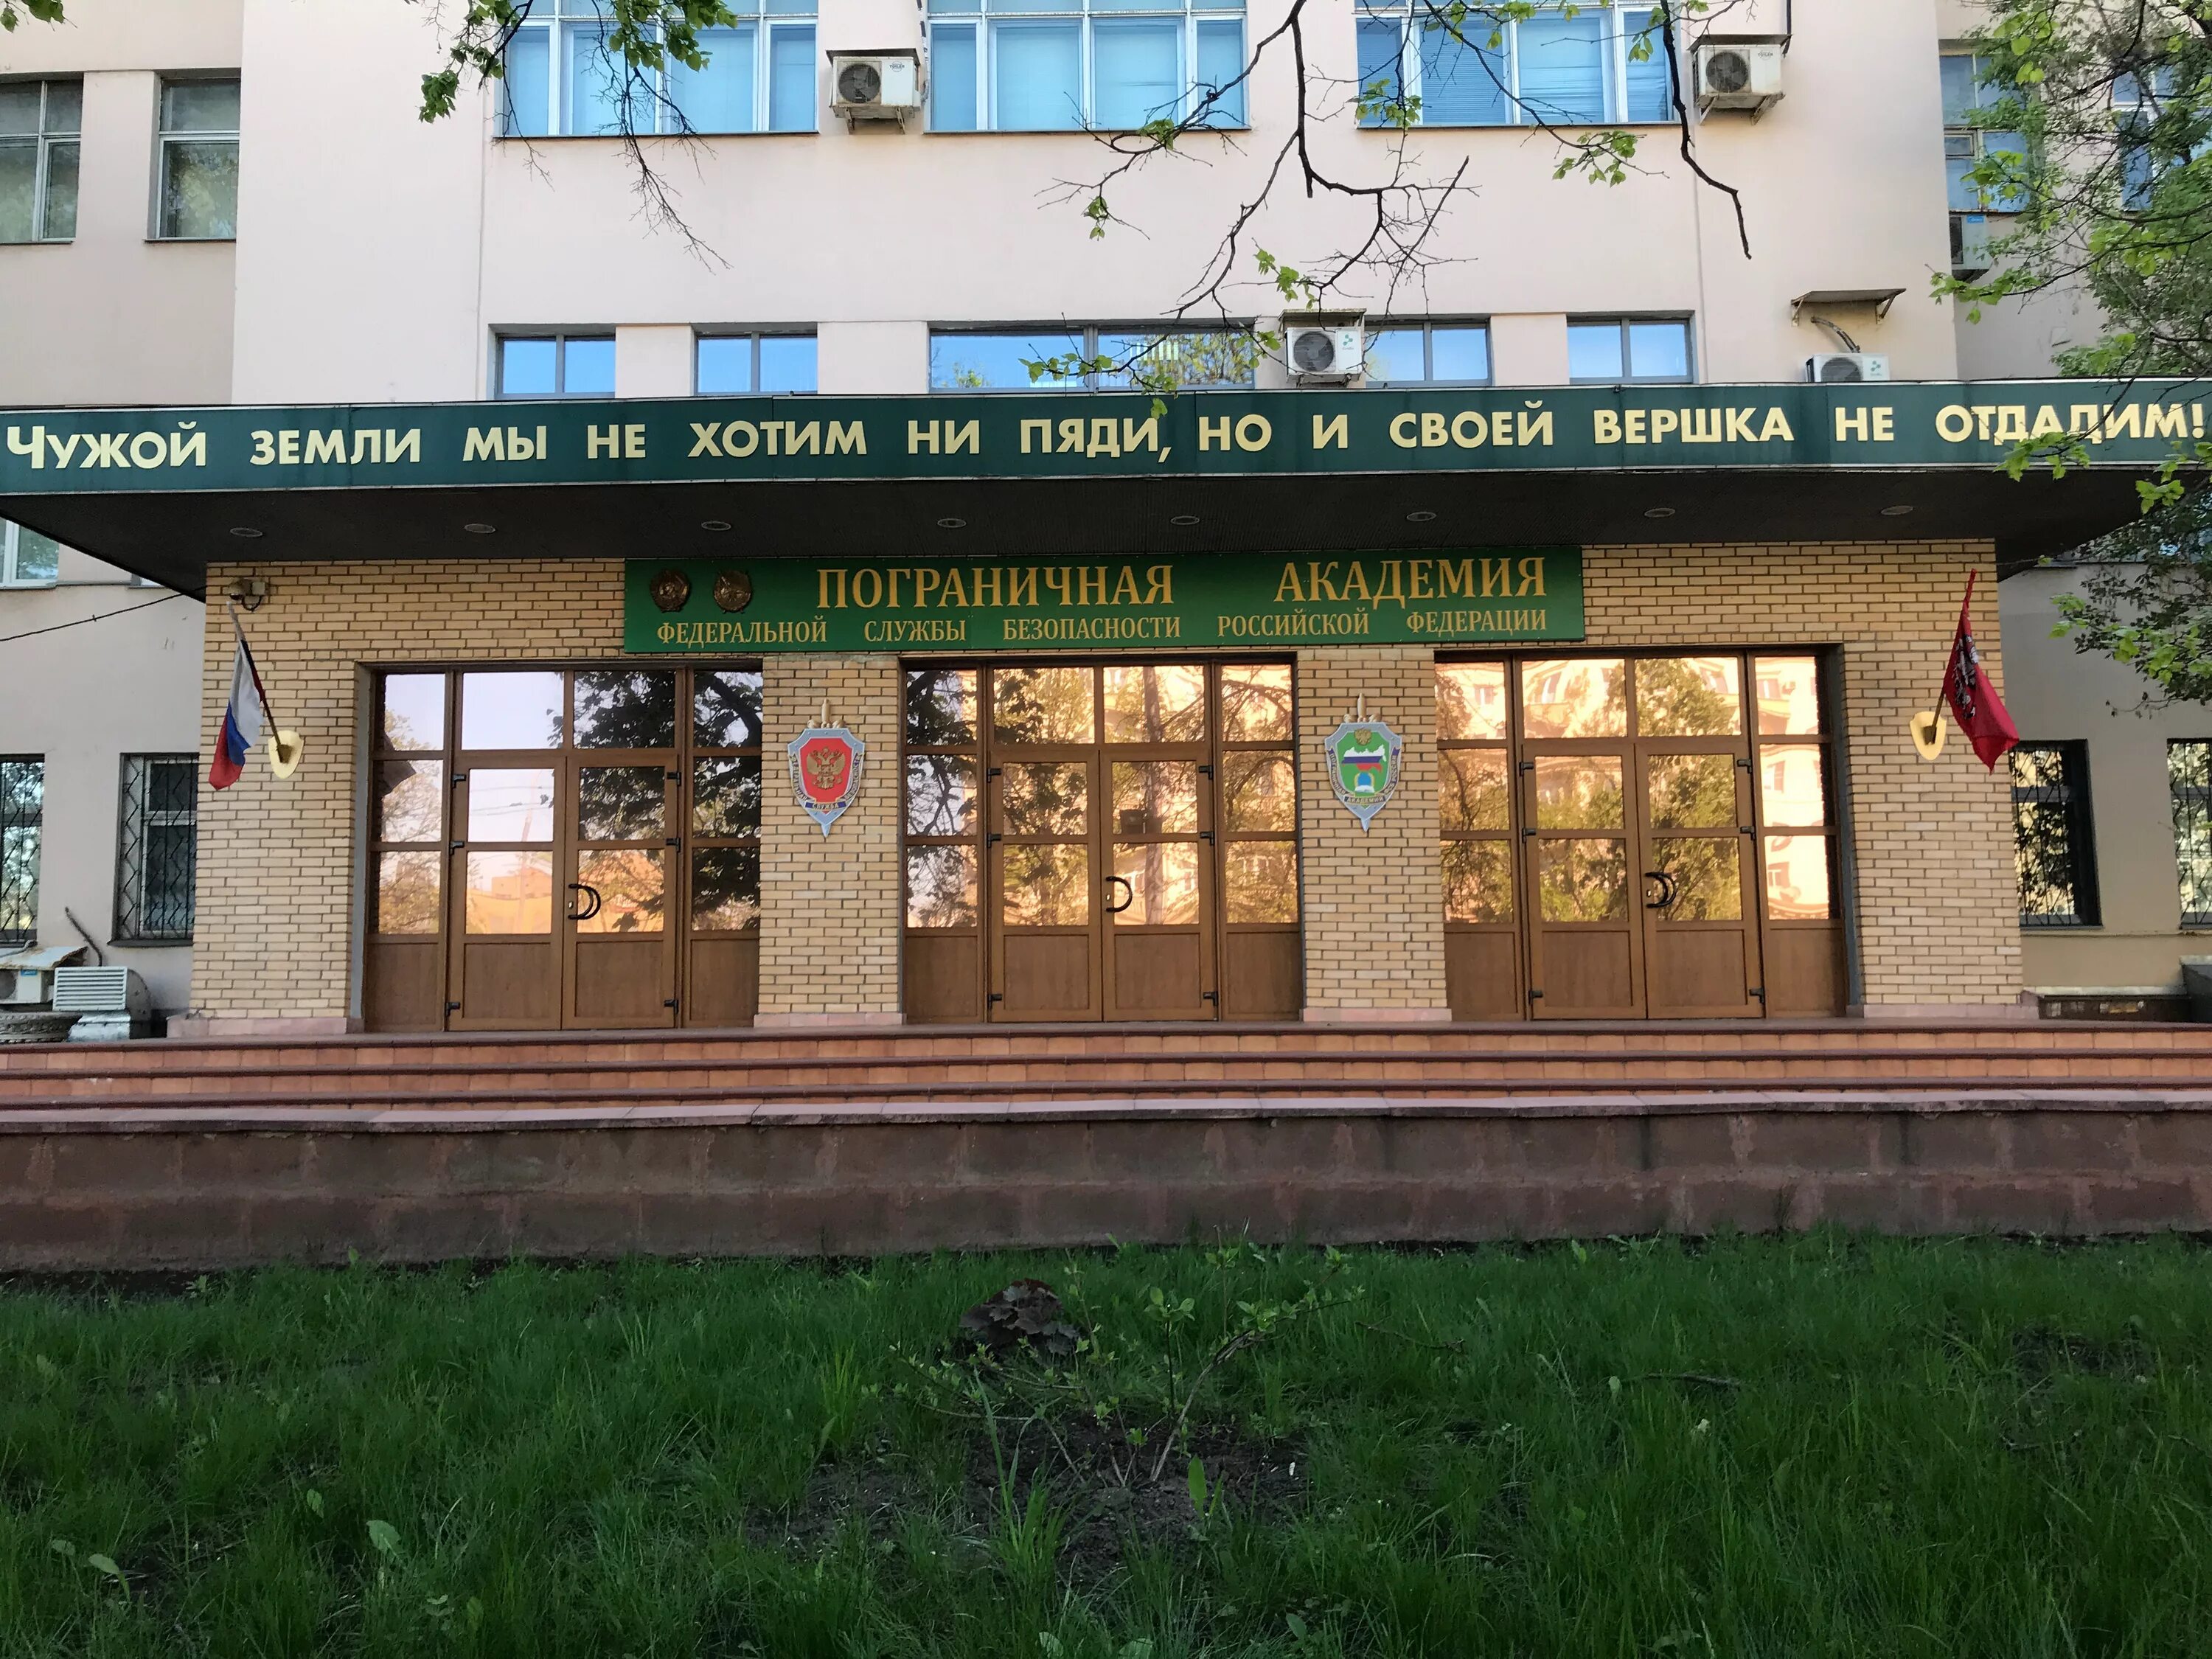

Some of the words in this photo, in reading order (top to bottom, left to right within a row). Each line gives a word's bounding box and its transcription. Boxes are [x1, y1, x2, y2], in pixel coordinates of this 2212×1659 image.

[7, 421, 206, 469] ЧУЖОЙ
[250, 428, 421, 465] ЗЕМЛИ
[462, 425, 547, 462] МЫ
[587, 423, 646, 459] НЕ
[689, 420, 868, 458] ХОТИМ
[907, 420, 981, 455] НИ
[1020, 417, 1172, 463] ПЯДИ,
[1198, 414, 1273, 452] НО
[1312, 414, 1349, 450] И
[1389, 400, 1554, 449] СВОЕЙ
[1593, 407, 1795, 445] ВЕРШКА
[1834, 406, 1895, 442] НЕ
[1935, 403, 2205, 445] ОТДАДИМ!
[816, 566, 1174, 609] ПОГРАНИЧНАЯ
[1273, 557, 1547, 610] АКАДЕМИЯ
[657, 615, 827, 649] ФЕДЕРАЛЬНОЙ
[863, 619, 967, 643] СЛУЖБЫ
[1003, 616, 1181, 641] БЕЗОПАСНОСТИ
[1217, 608, 1370, 637] РОССИЙСКОЙ
[1406, 609, 1547, 637] ФЕДЕРАЦИИ
